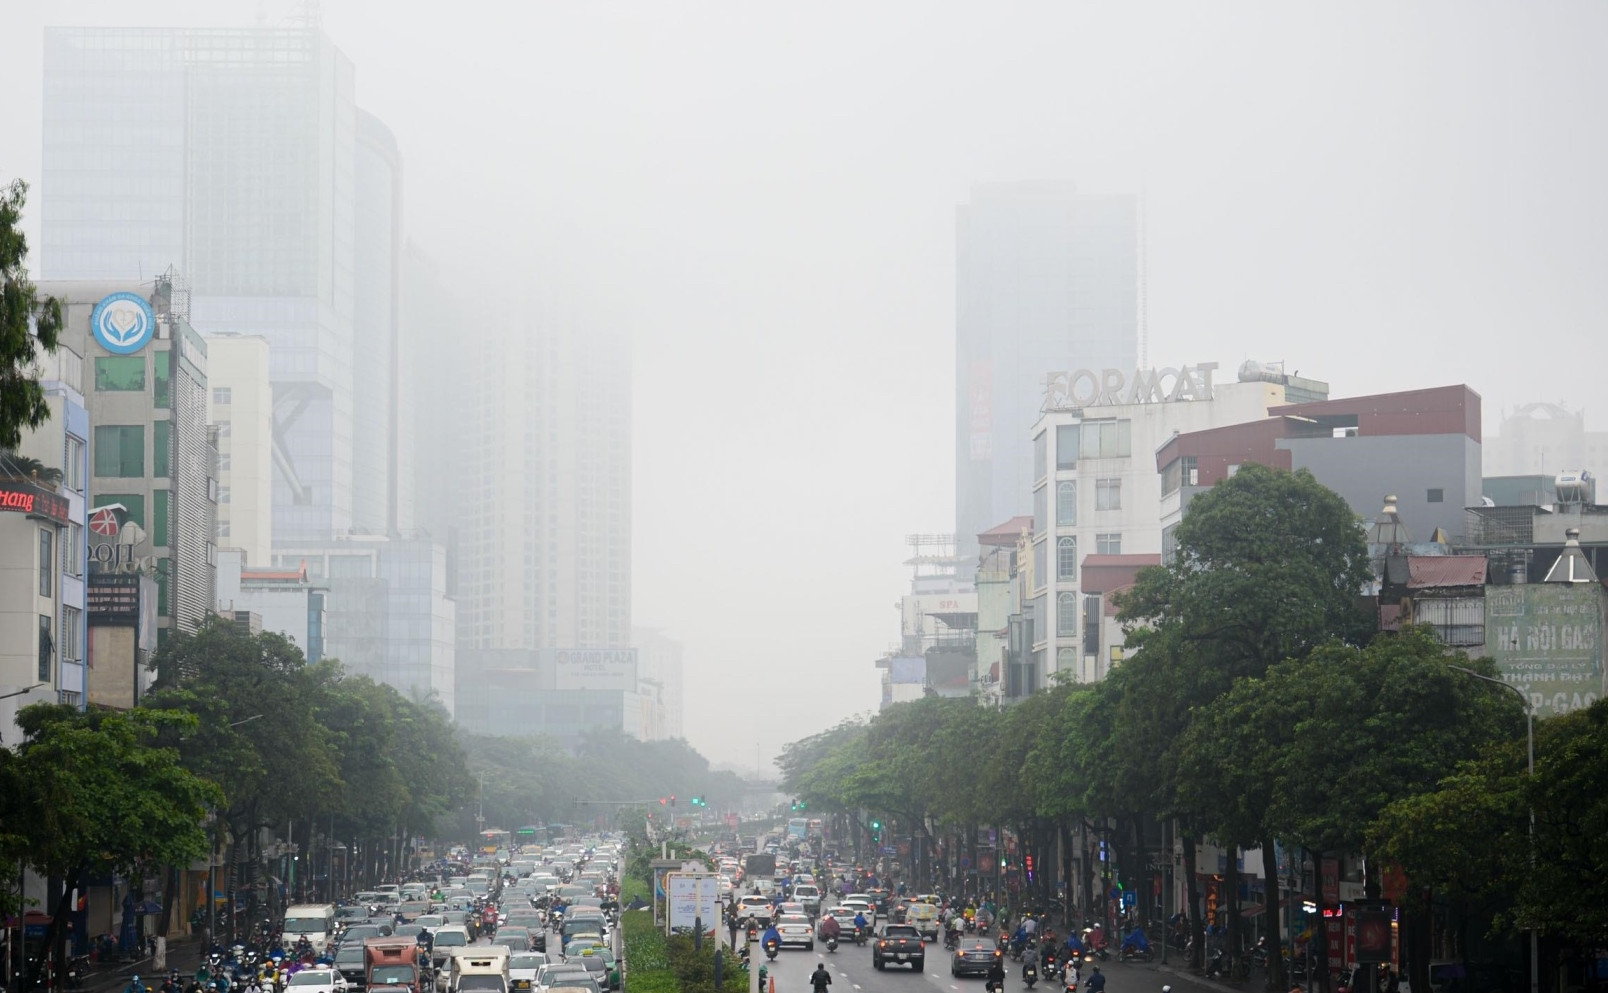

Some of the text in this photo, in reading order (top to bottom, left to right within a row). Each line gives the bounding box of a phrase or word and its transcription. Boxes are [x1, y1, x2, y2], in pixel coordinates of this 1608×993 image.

[1046, 361, 1219, 410] FORMAT
[88, 543, 134, 571] OJI
[940, 599, 959, 609] SPA
[1497, 621, 1520, 651] HÀ
[1561, 622, 1595, 650] GAS
[570, 651, 633, 665] GRAND PLAZA
